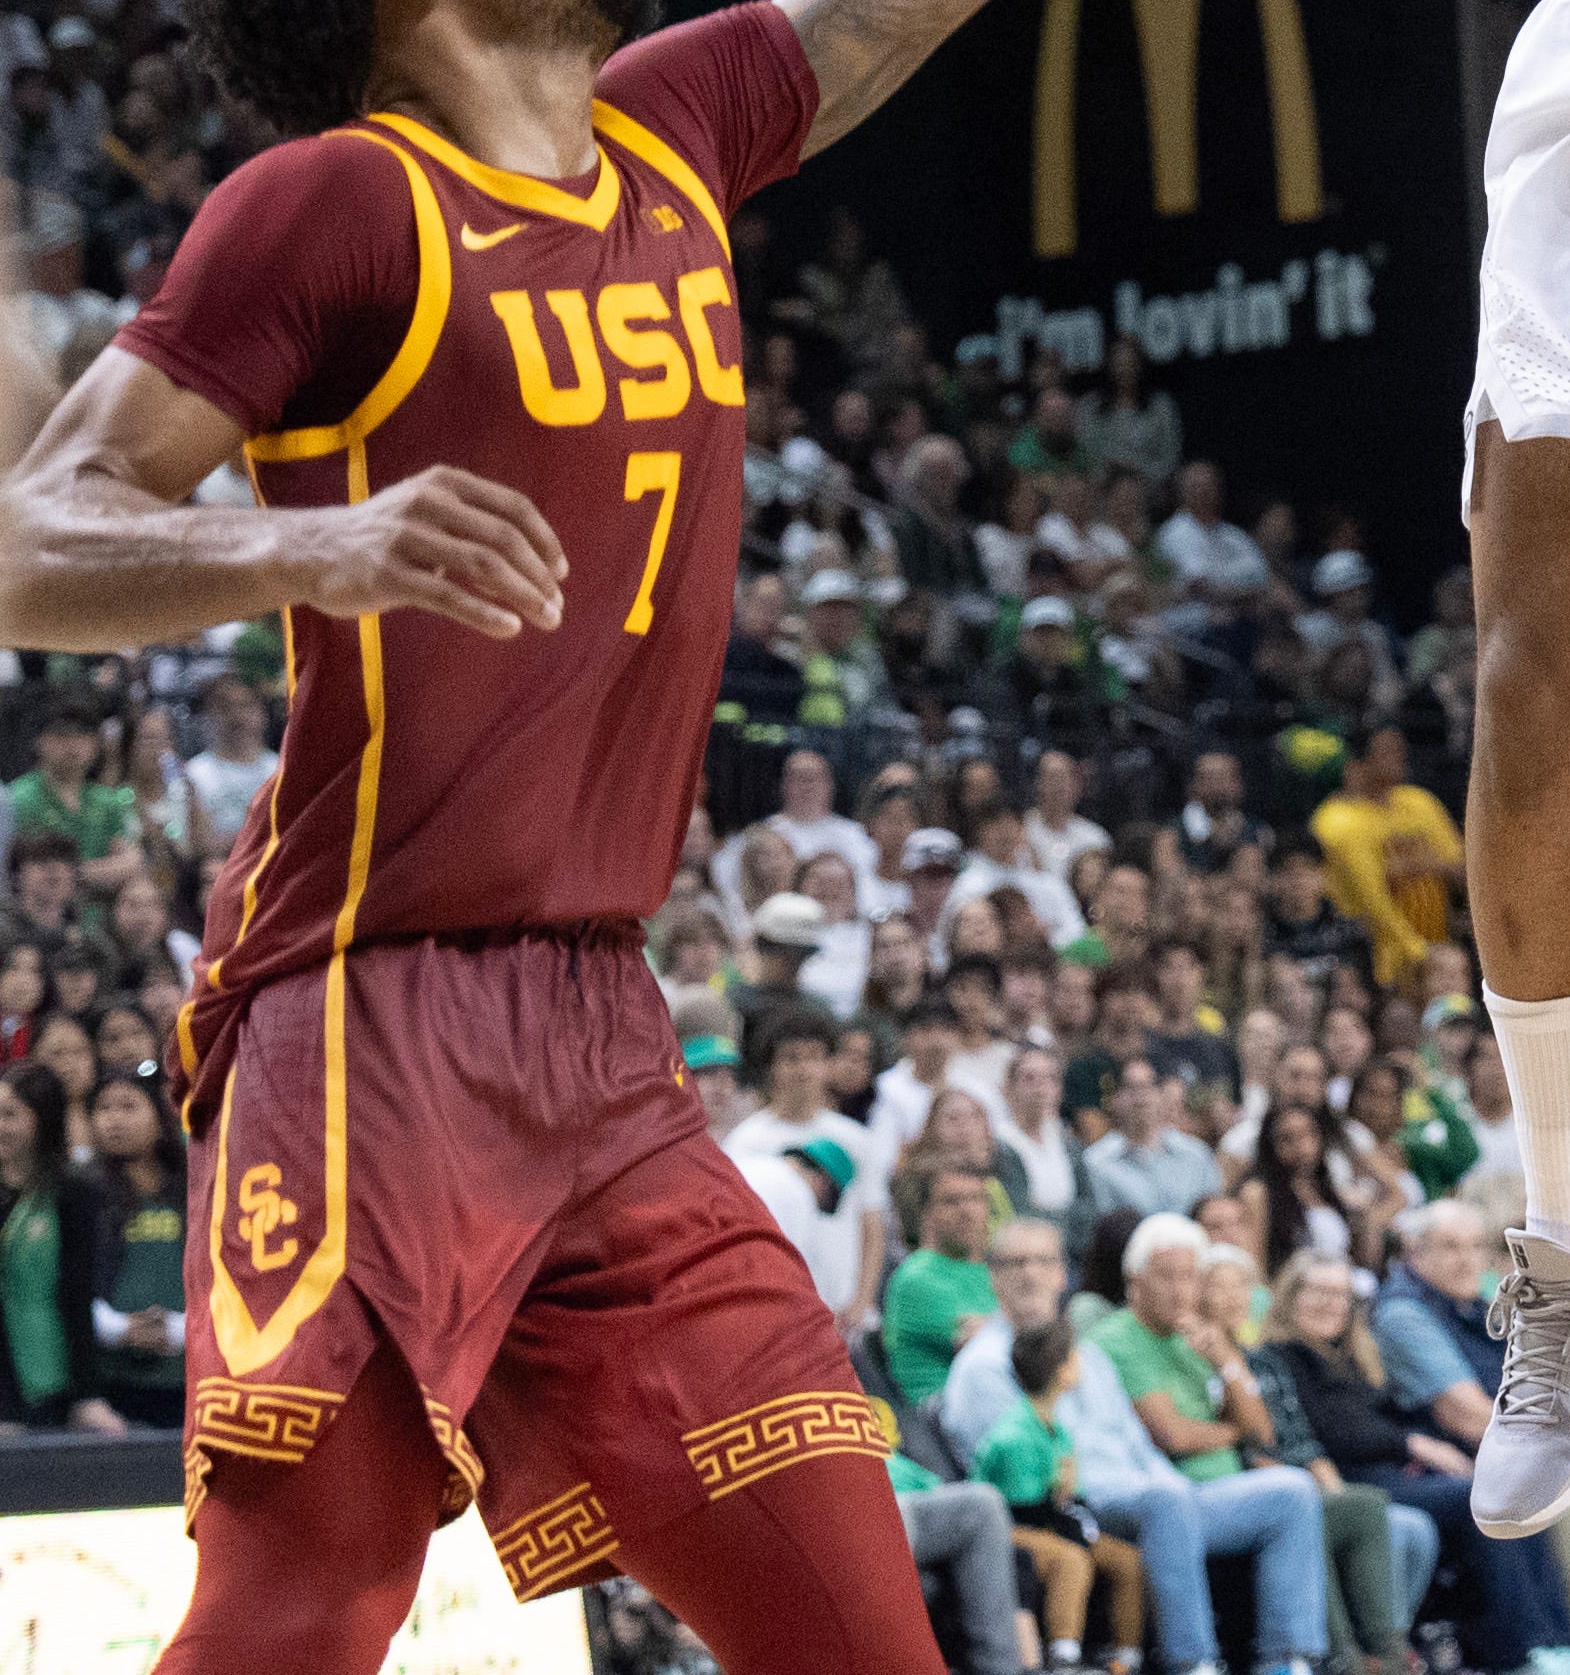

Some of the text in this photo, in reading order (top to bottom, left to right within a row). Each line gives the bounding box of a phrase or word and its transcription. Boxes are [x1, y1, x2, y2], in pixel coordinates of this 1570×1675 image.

[489, 266, 746, 427] USC
[1314, 249, 1376, 340] it
[623, 451, 682, 636] 7
